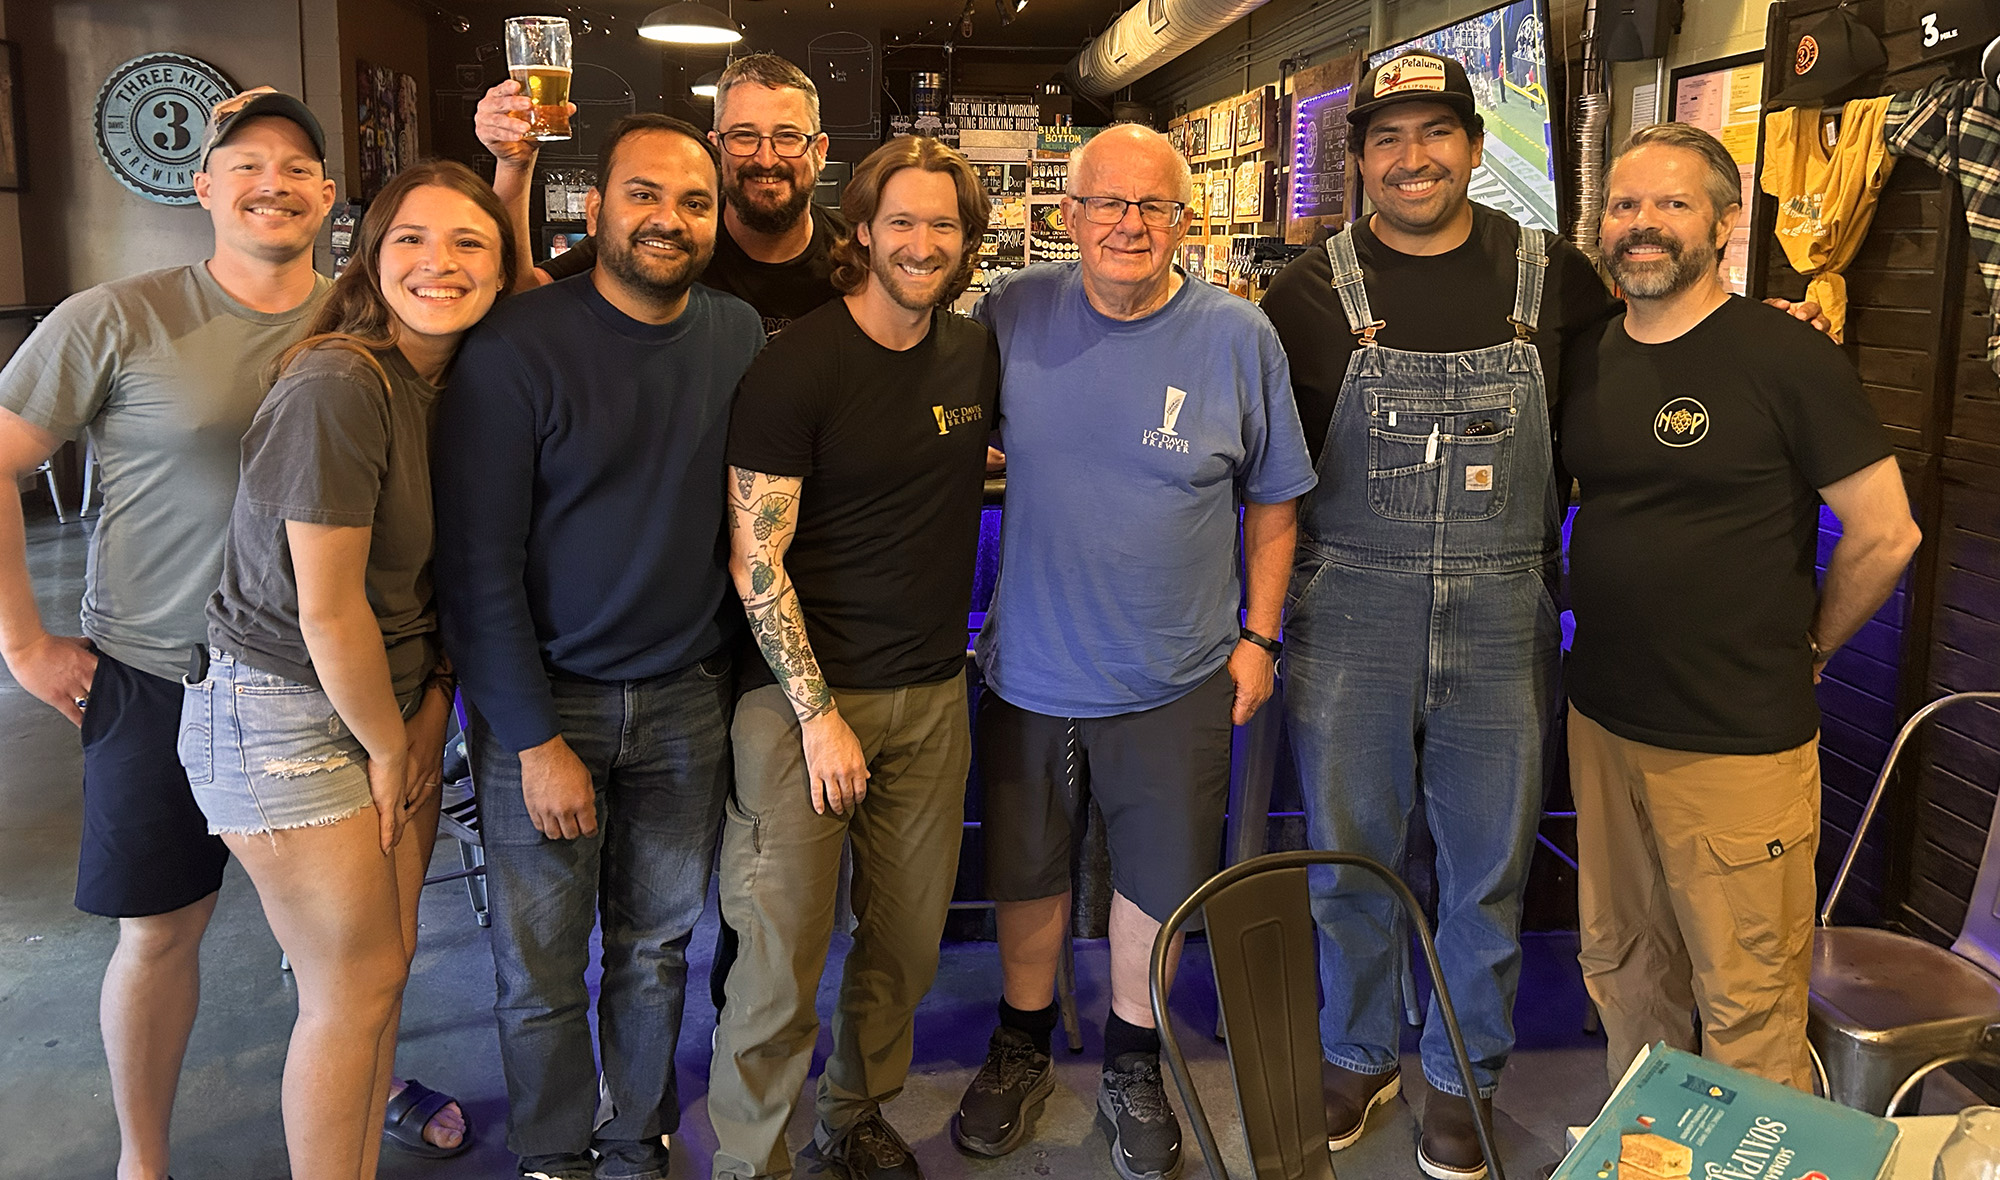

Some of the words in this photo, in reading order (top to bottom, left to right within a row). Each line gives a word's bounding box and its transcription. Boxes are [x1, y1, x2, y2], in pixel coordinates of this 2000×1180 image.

[1921, 12, 1939, 47] 3
[1940, 28, 1958, 41] MILE
[1401, 58, 1442, 71] Petaluma
[115, 68, 174, 102] THREE
[179, 70, 222, 107] MILE
[949, 102, 969, 116] THERE
[970, 103, 986, 117] WILL
[987, 103, 996, 117] BE
[997, 103, 1007, 117] NO
[1008, 103, 1040, 118] WORKING
[107, 121, 124, 129] DAVIS
[153, 100, 191, 151] 3
[890, 115, 910, 123] HEAD
[960, 117, 976, 130] RING
[978, 117, 1014, 130] DRINKING
[1015, 117, 1040, 131] HOURS
[1038, 125, 1072, 135] BIKINI
[1045, 134, 1082, 143] BOTTOM
[1032, 164, 1068, 178] BOARD
[1008, 175, 1025, 188] Door
[945, 409, 960, 420] UC
[960, 404, 982, 416] DAVIS
[948, 412, 983, 427] BREWER
[1143, 429, 1160, 441] UC
[1161, 434, 1190, 447] DAVIS
[1142, 437, 1190, 454] BREWER
